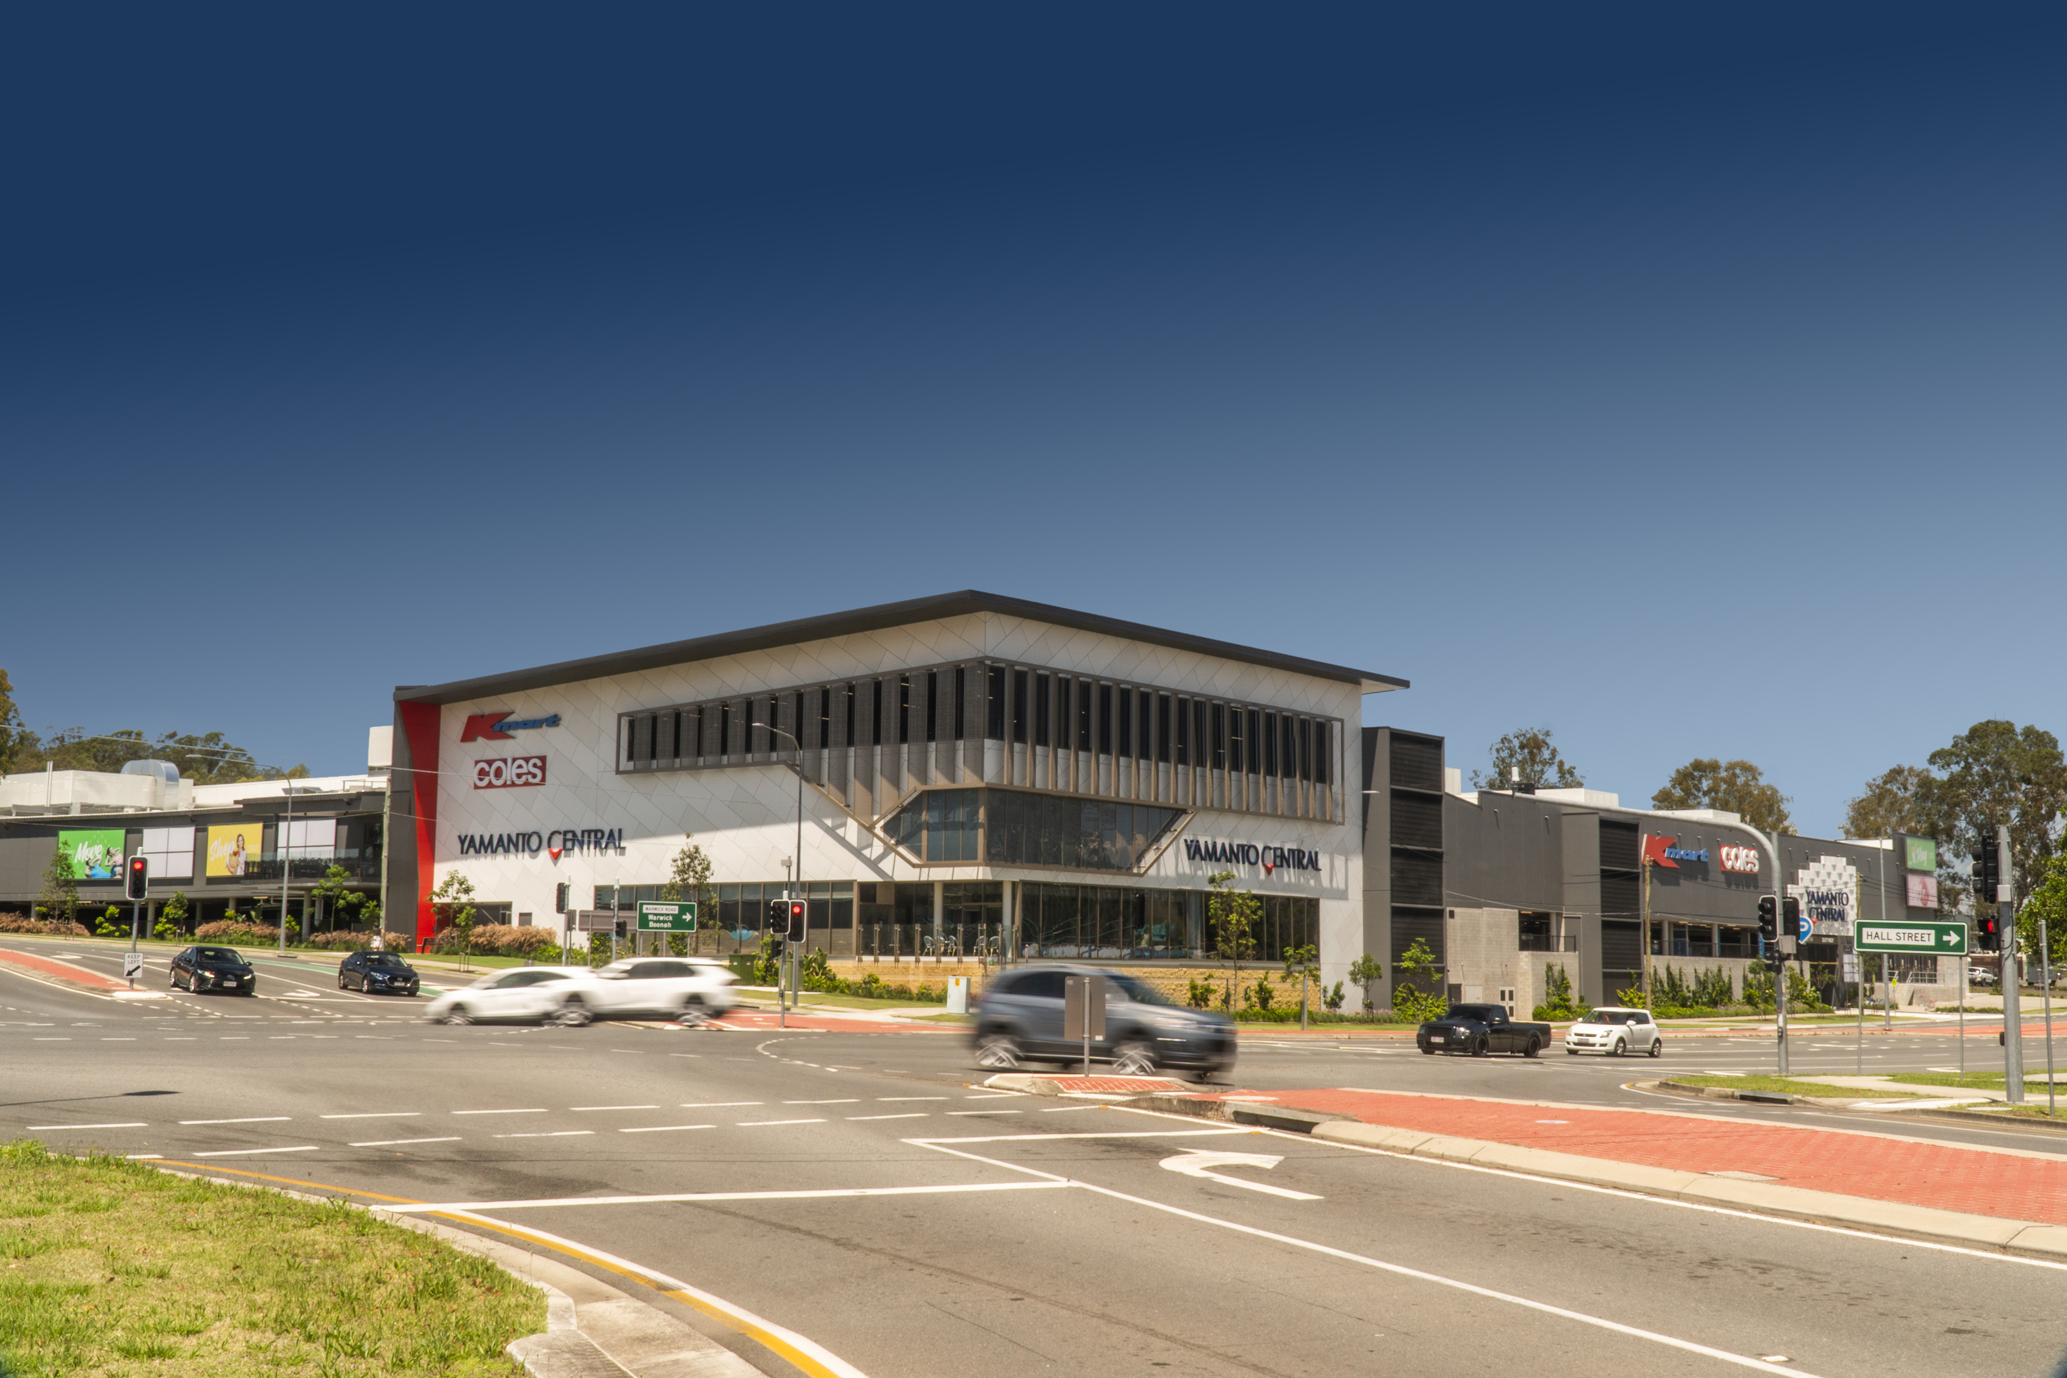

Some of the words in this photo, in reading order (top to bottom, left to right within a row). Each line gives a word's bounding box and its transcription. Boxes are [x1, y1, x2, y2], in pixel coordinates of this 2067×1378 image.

[474, 757, 543, 788] coles
[75, 841, 103, 863] Move
[457, 831, 542, 855] YAMANTO
[547, 828, 626, 860] CENTRAL
[1184, 839, 1259, 866] YAMANTO
[1261, 845, 1322, 875] CENTRAL
[1721, 846, 1759, 872] coles
[1805, 889, 1849, 906] YAMANTO
[1809, 907, 1847, 925] CENTRAL
[1866, 931, 1892, 941] HALL
[1895, 932, 1931, 942] STREET
